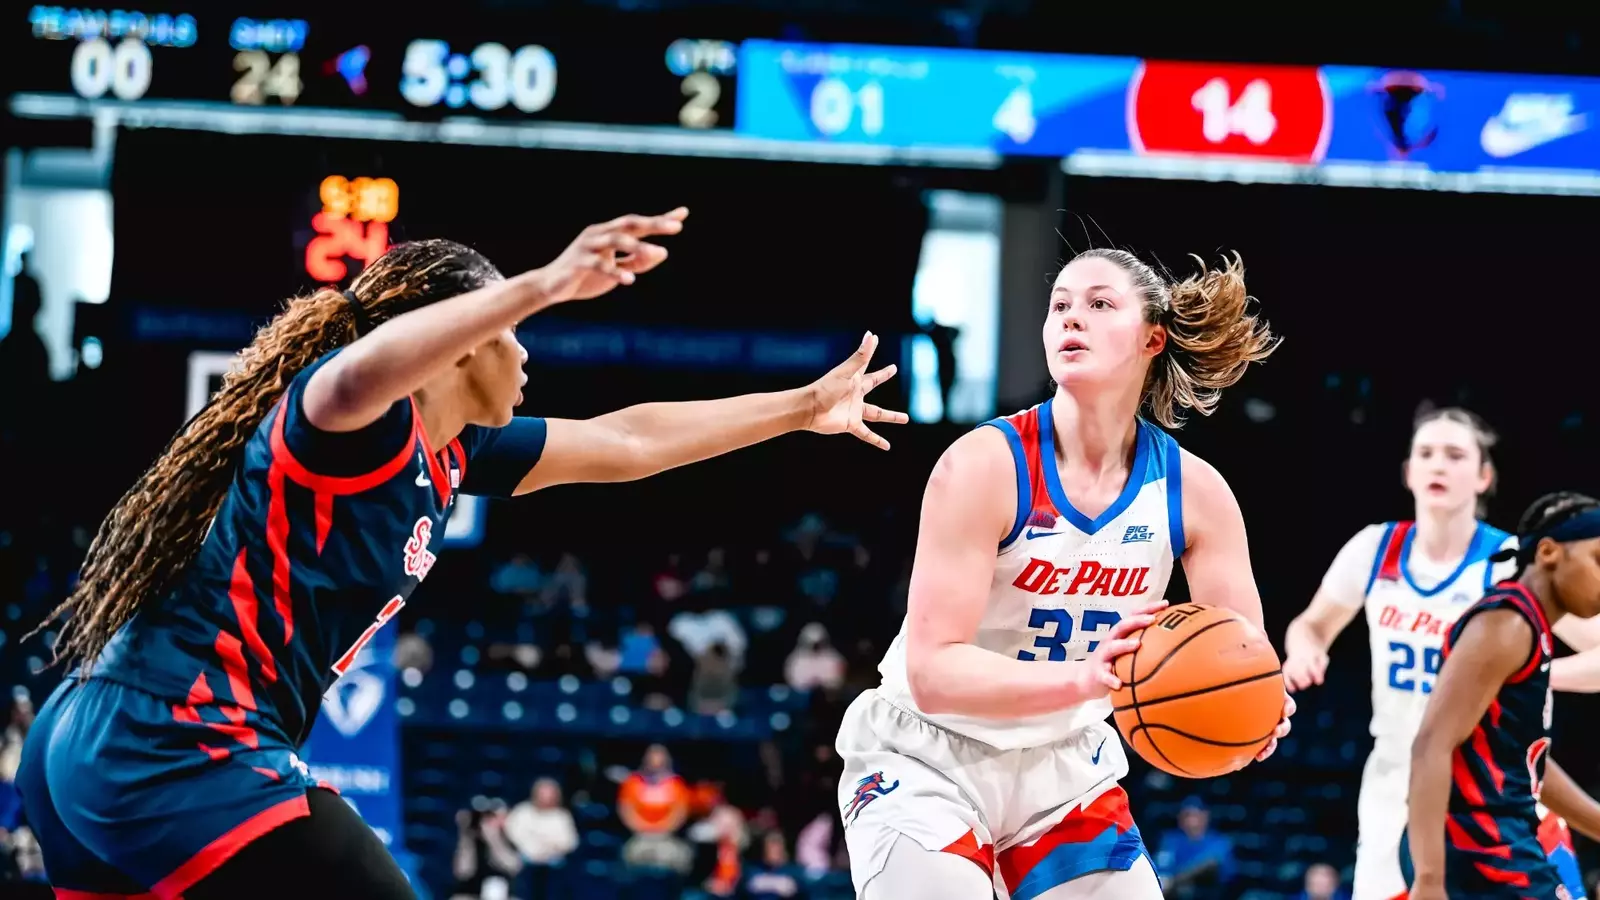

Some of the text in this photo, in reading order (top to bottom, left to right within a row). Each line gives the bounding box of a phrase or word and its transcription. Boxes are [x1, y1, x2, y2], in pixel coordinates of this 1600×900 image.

[71, 37, 153, 100] 00
[230, 49, 303, 105] 24
[400, 38, 557, 113] 5:30
[678, 71, 721, 129] 2
[811, 78, 884, 137] 01
[992, 86, 1036, 144] 4
[1191, 77, 1277, 145] 14
[1122, 532, 1155, 541] EAST
[1126, 525, 1149, 533] BIG
